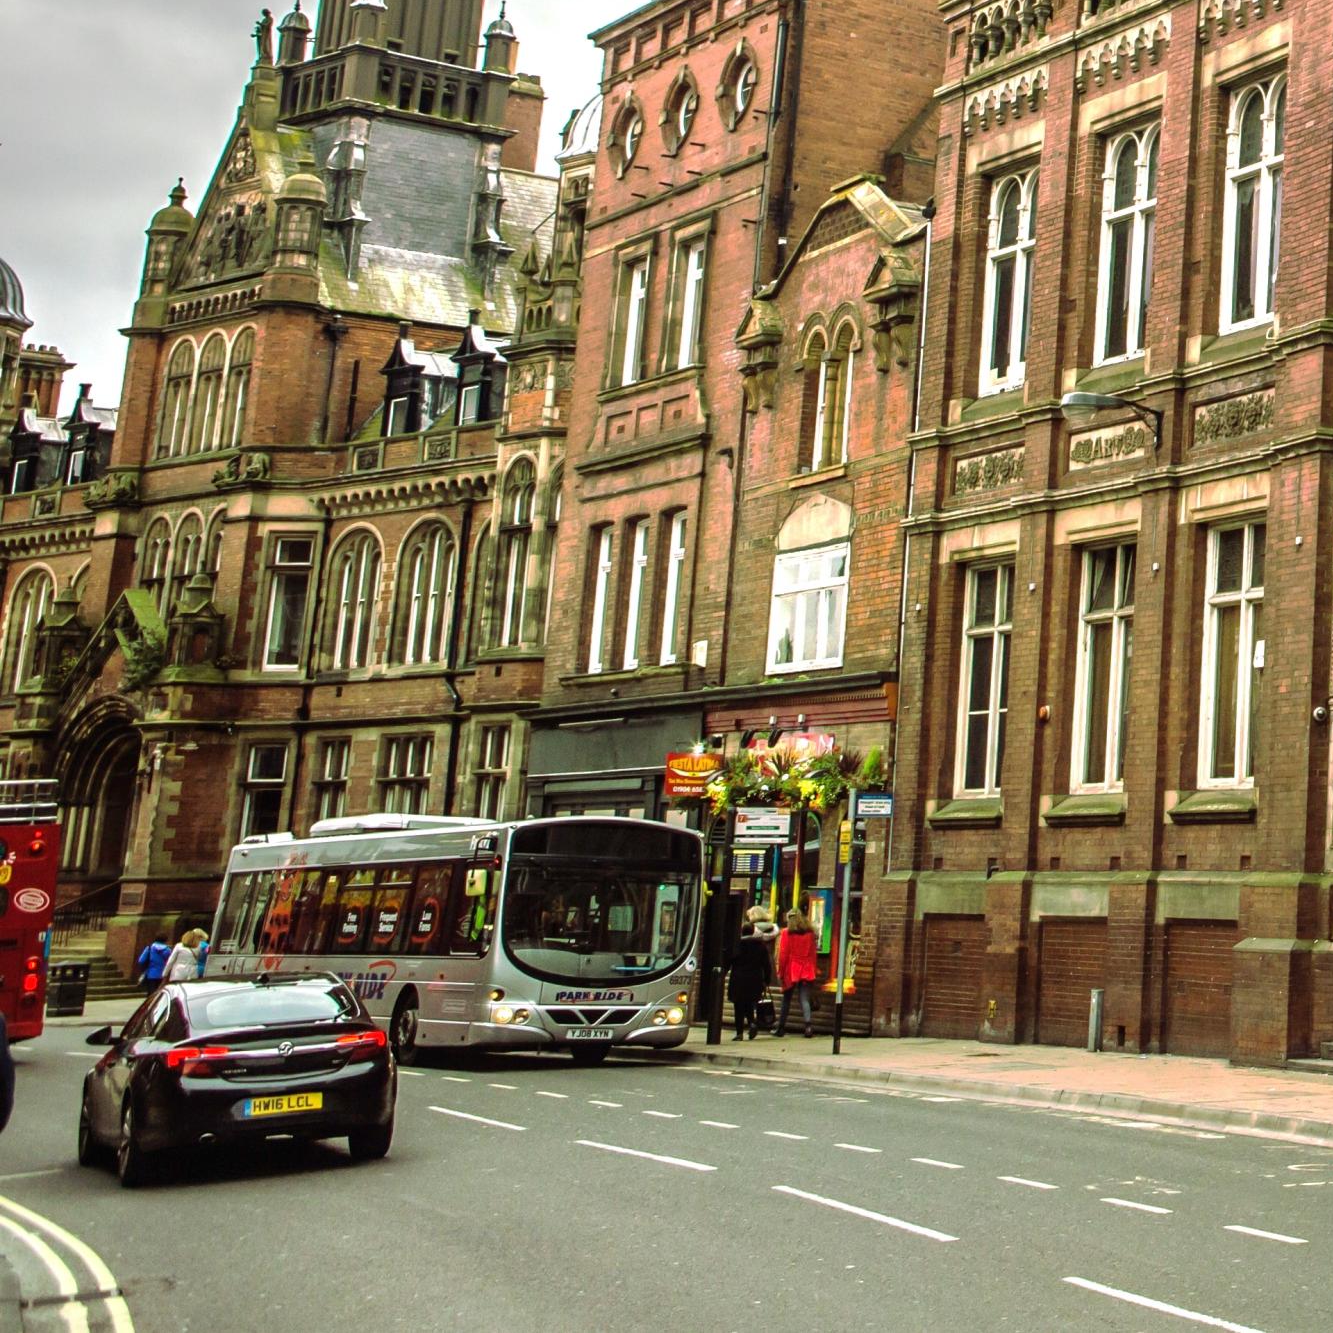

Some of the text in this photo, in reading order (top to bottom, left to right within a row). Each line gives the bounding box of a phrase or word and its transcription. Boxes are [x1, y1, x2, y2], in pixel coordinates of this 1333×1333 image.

[558, 991, 625, 1002] PARK RIDE
[253, 1095, 313, 1113] HW16 LCL
